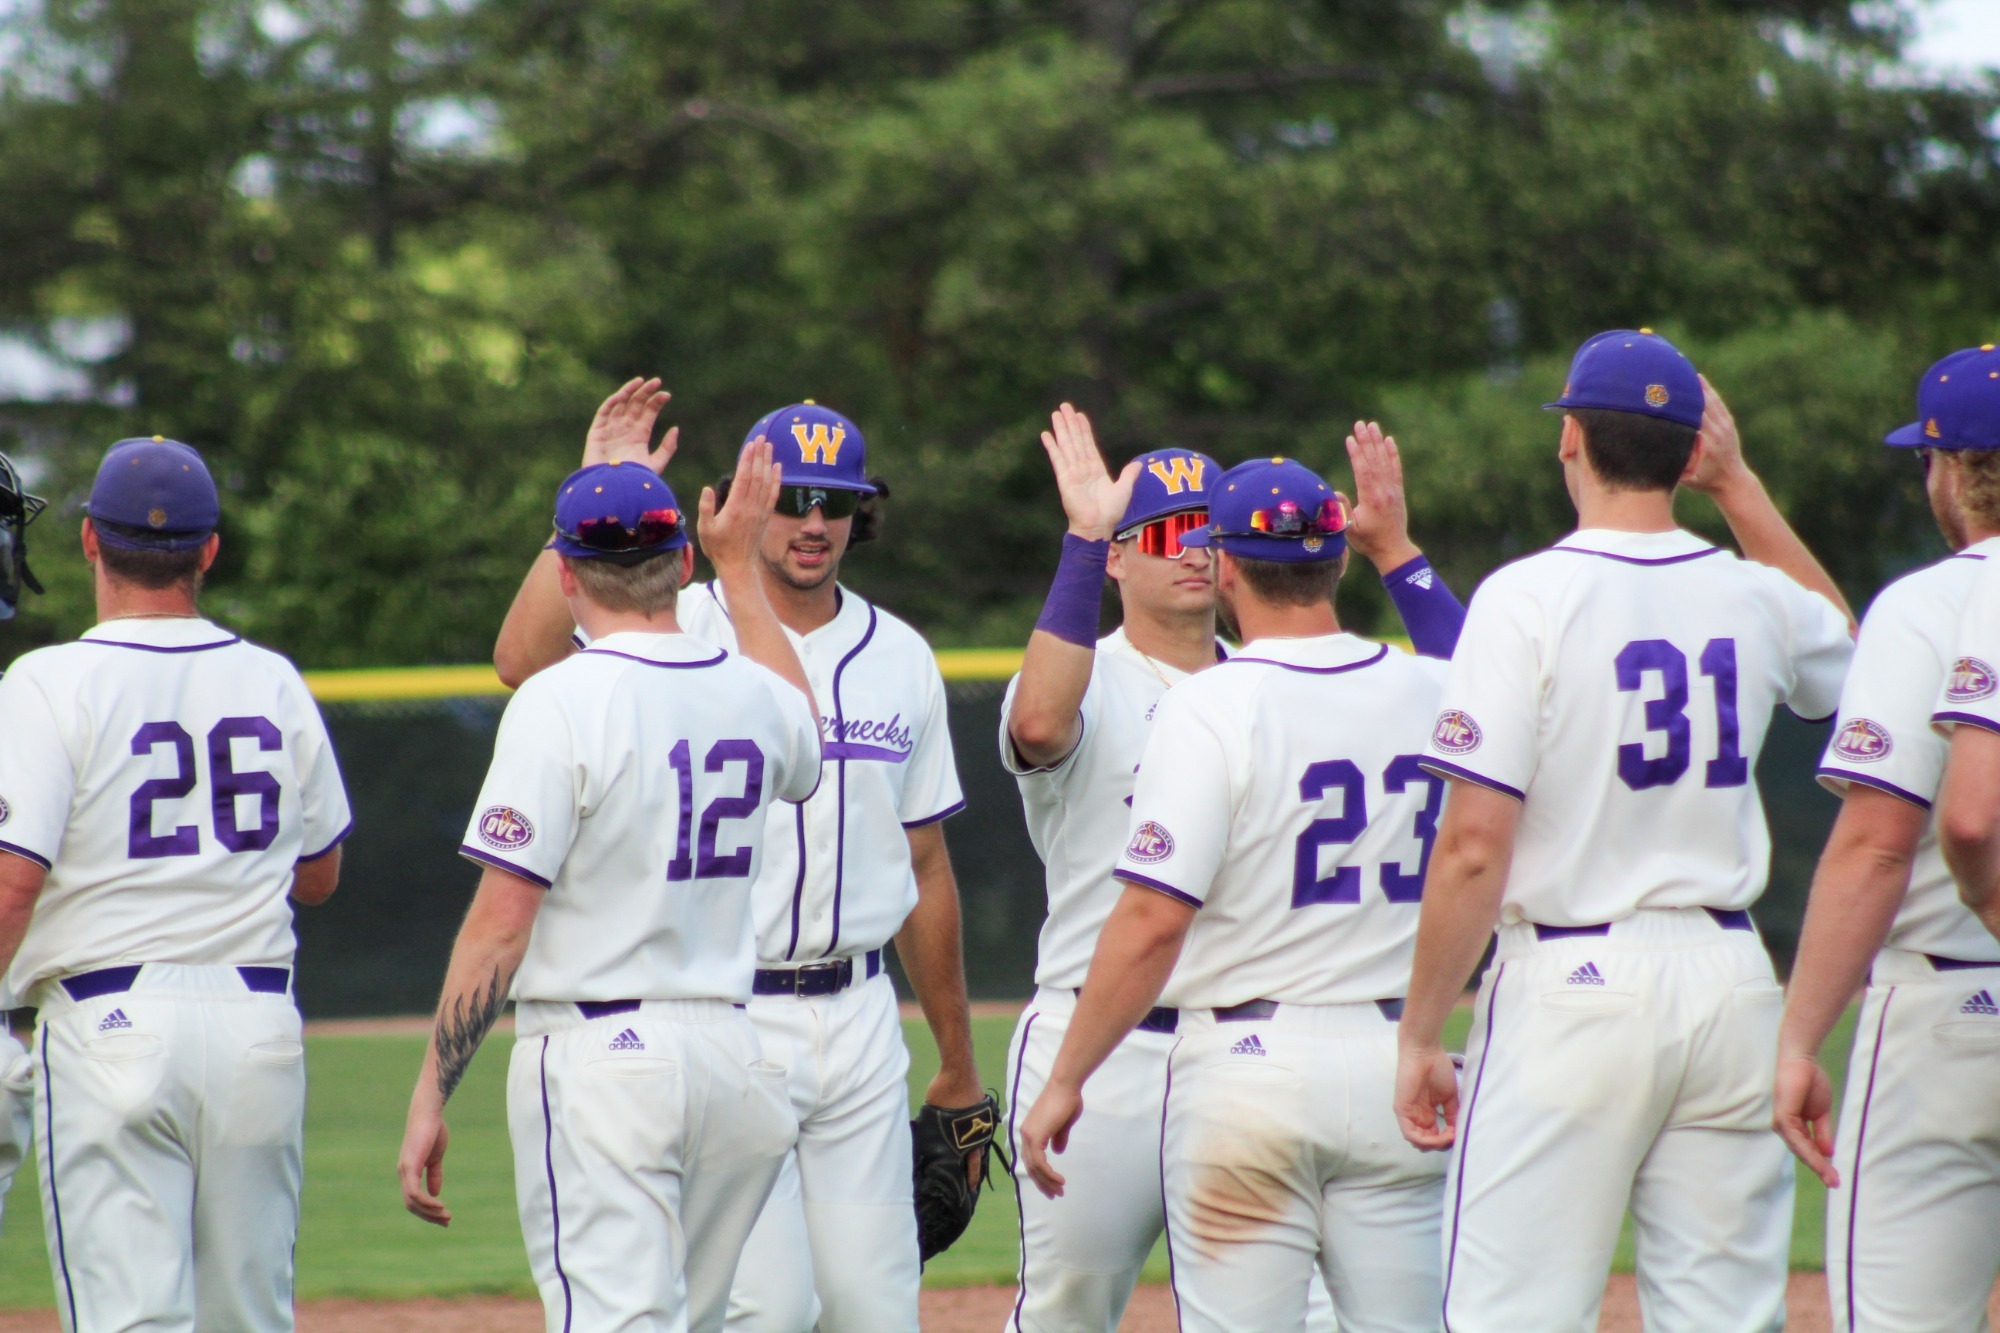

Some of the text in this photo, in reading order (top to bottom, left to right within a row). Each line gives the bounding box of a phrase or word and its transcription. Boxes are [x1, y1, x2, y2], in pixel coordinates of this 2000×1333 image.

[791, 424, 846, 466] W
[1148, 456, 1205, 496] W
[1405, 567, 1431, 585] adidas
[1614, 637, 1748, 791] 31
[128, 716, 282, 859] 26
[667, 738, 764, 881] 12
[485, 816, 522, 842] OVC
[1290, 754, 1445, 910] 23
[1566, 973, 1606, 986] adidas
[1960, 1003, 2000, 1016] adidas
[98, 1019, 132, 1031] adidas
[609, 1040, 646, 1051] adidas
[1230, 1044, 1267, 1057] adidas
